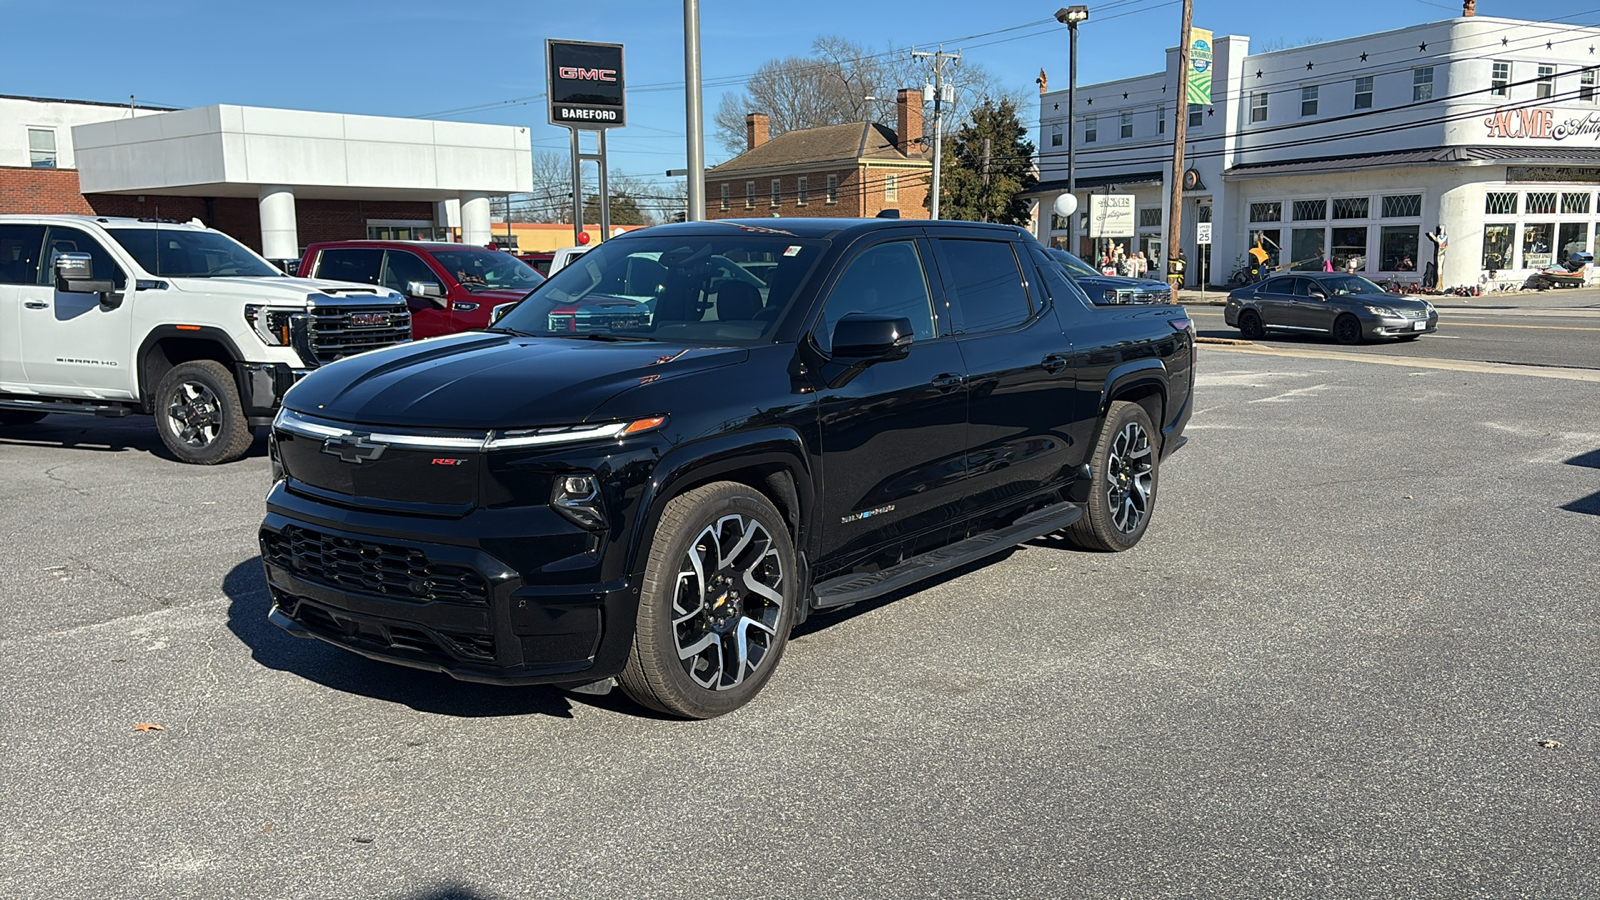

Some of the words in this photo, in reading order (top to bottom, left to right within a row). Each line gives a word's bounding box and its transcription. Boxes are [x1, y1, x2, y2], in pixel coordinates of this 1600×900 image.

[559, 67, 616, 81] GMC
[561, 108, 616, 120] BAREFORD
[1484, 109, 1554, 138] ACME
[1198, 233, 1210, 241] 25
[353, 313, 390, 325] GMC
[431, 458, 468, 466] RST
[841, 504, 896, 523] SILVERADO
